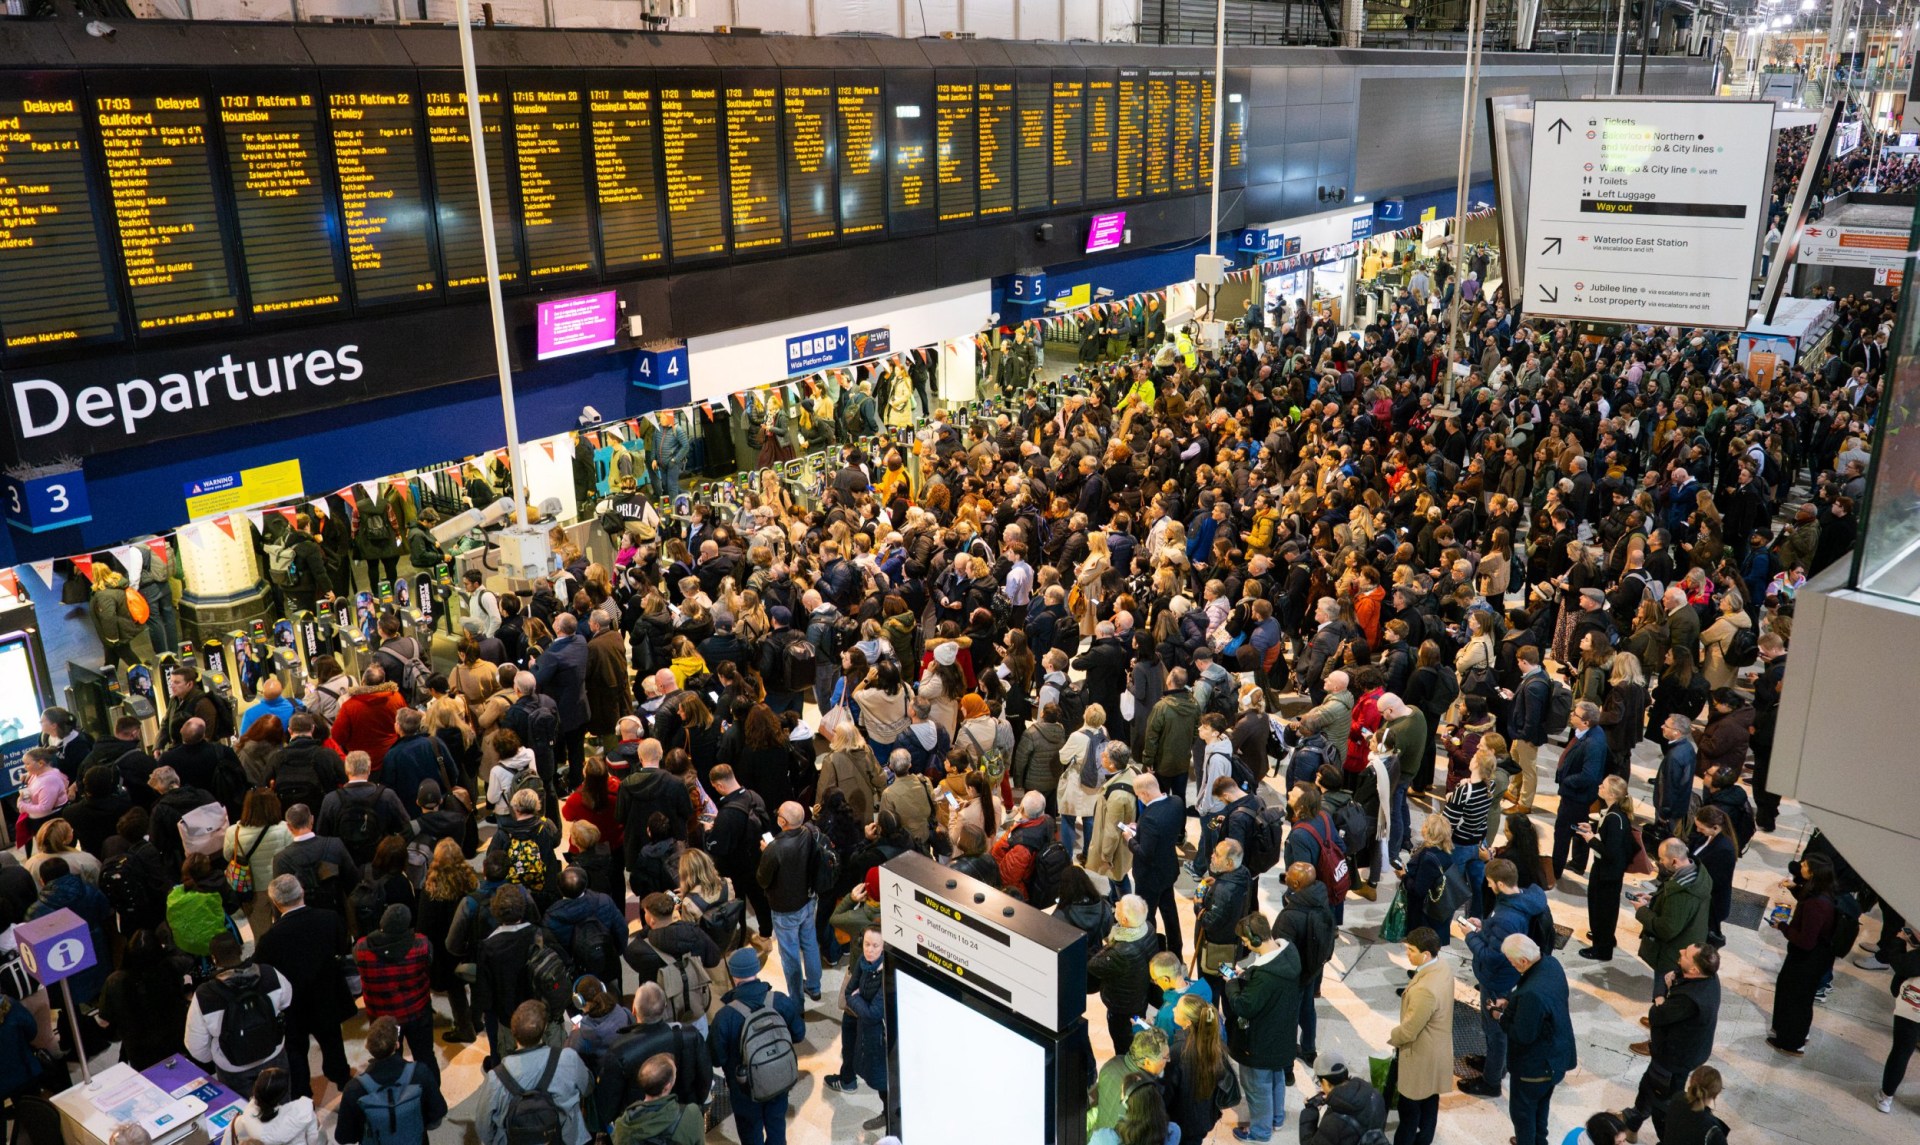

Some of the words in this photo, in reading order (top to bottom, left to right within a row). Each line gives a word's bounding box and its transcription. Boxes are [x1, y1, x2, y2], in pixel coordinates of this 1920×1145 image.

[427, 93, 450, 103] 17:15
[493, 93, 498, 102] 4
[513, 92, 534, 101] 17:15
[538, 92, 566, 100] Platform
[568, 92, 577, 100] 20
[591, 90, 609, 100] 17:17
[624, 90, 649, 100] Delayed
[692, 90, 714, 98] Delayed
[98, 98, 131, 110] 17:03
[156, 97, 200, 110] Delayed
[221, 96, 249, 107] 17:07
[257, 96, 296, 107] Platform
[301, 95, 310, 105] 18
[330, 95, 355, 105] 17:13
[360, 94, 396, 104] Platform
[398, 94, 409, 104] 22
[727, 100, 761, 108] Southampton
[24, 100, 73, 113] Delayed
[514, 105, 547, 114] Hounslow
[591, 102, 627, 112] Chessington
[629, 102, 646, 110] South
[662, 101, 682, 110] Woking
[222, 110, 268, 122] Hounslow
[330, 108, 362, 119] Frimley
[428, 106, 464, 116] Guildford
[99, 113, 152, 126] Guildford
[116, 128, 148, 136] Cobham
[103, 139, 129, 147] Calling
[163, 137, 180, 146] Page
[1672, 145, 1690, 154] City
[1693, 144, 1714, 153] lines
[107, 159, 137, 168] Clapham
[140, 158, 172, 166] Junction
[109, 168, 147, 177] Earlsfield
[1652, 166, 1669, 175] City
[111, 179, 148, 188] Wimbledon
[1618, 191, 1655, 200] Luggage
[1386, 205, 1392, 214] 7
[1596, 202, 1615, 212] Way
[116, 209, 149, 218] Claygate
[4, 217, 36, 228] Byfleet
[119, 218, 150, 227] Oxshott
[122, 237, 159, 247] Effingham
[1245, 234, 1252, 245] 6
[1261, 233, 1265, 245] 6
[1594, 235, 1633, 245] Waterloo
[1657, 238, 1688, 247] Station
[1015, 280, 1023, 295] 5
[1035, 280, 1041, 295] 5
[1590, 284, 1620, 292] Jubilee
[1622, 285, 1638, 293] line
[1609, 298, 1646, 307] property
[8, 336, 36, 346] London
[667, 356, 679, 376] 4
[803, 357, 821, 366] Platform
[640, 358, 651, 377] 4
[12, 344, 363, 438] Departures
[203, 476, 233, 487] WARNING
[8, 486, 21, 513] 3
[46, 484, 69, 512] 3
[925, 897, 939, 910] Way
[940, 906, 950, 916] out
[927, 919, 956, 940] Platforms
[962, 937, 968, 945] to
[970, 940, 978, 950] 24
[928, 940, 968, 966] Underground
[928, 951, 941, 964] Way
[942, 960, 953, 970] out
